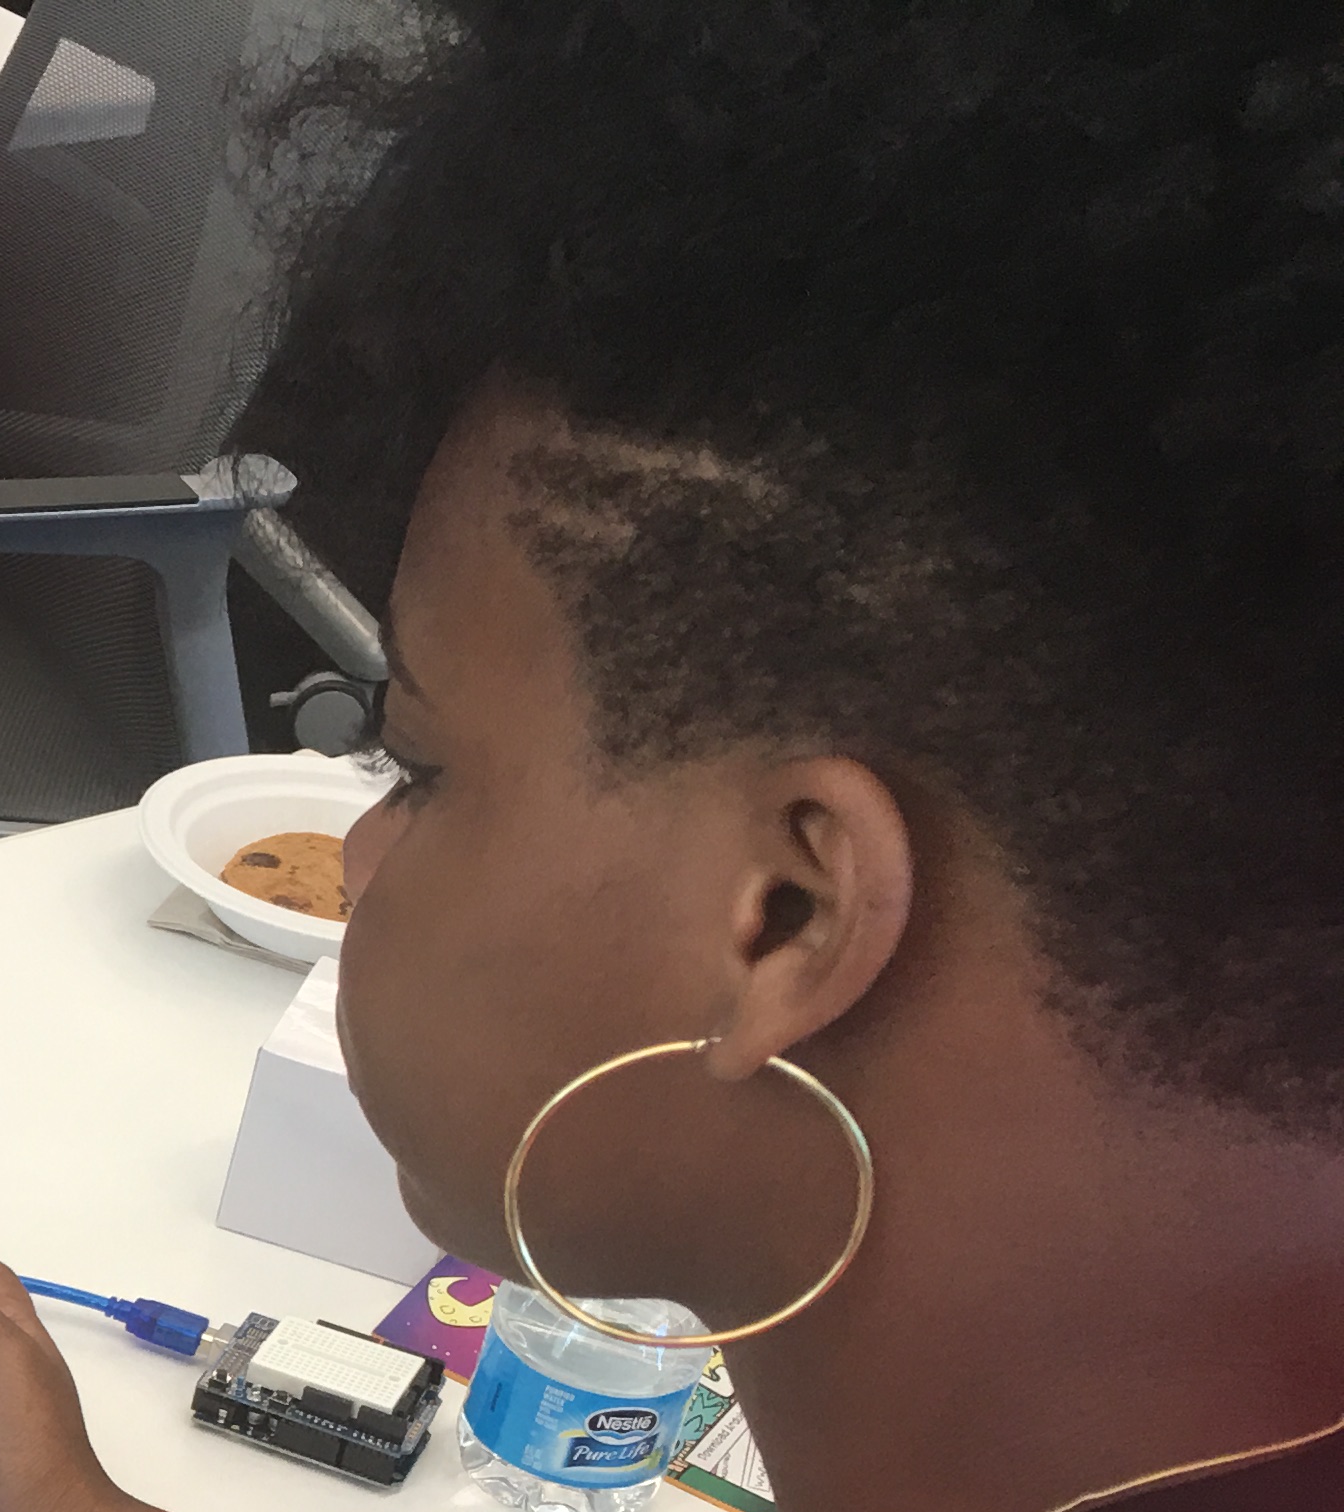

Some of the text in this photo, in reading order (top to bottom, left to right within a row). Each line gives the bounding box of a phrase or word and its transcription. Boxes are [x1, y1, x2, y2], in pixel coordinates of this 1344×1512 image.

[596, 1414, 652, 1432] Nestlé
[572, 1442, 651, 1461] Pure Life
